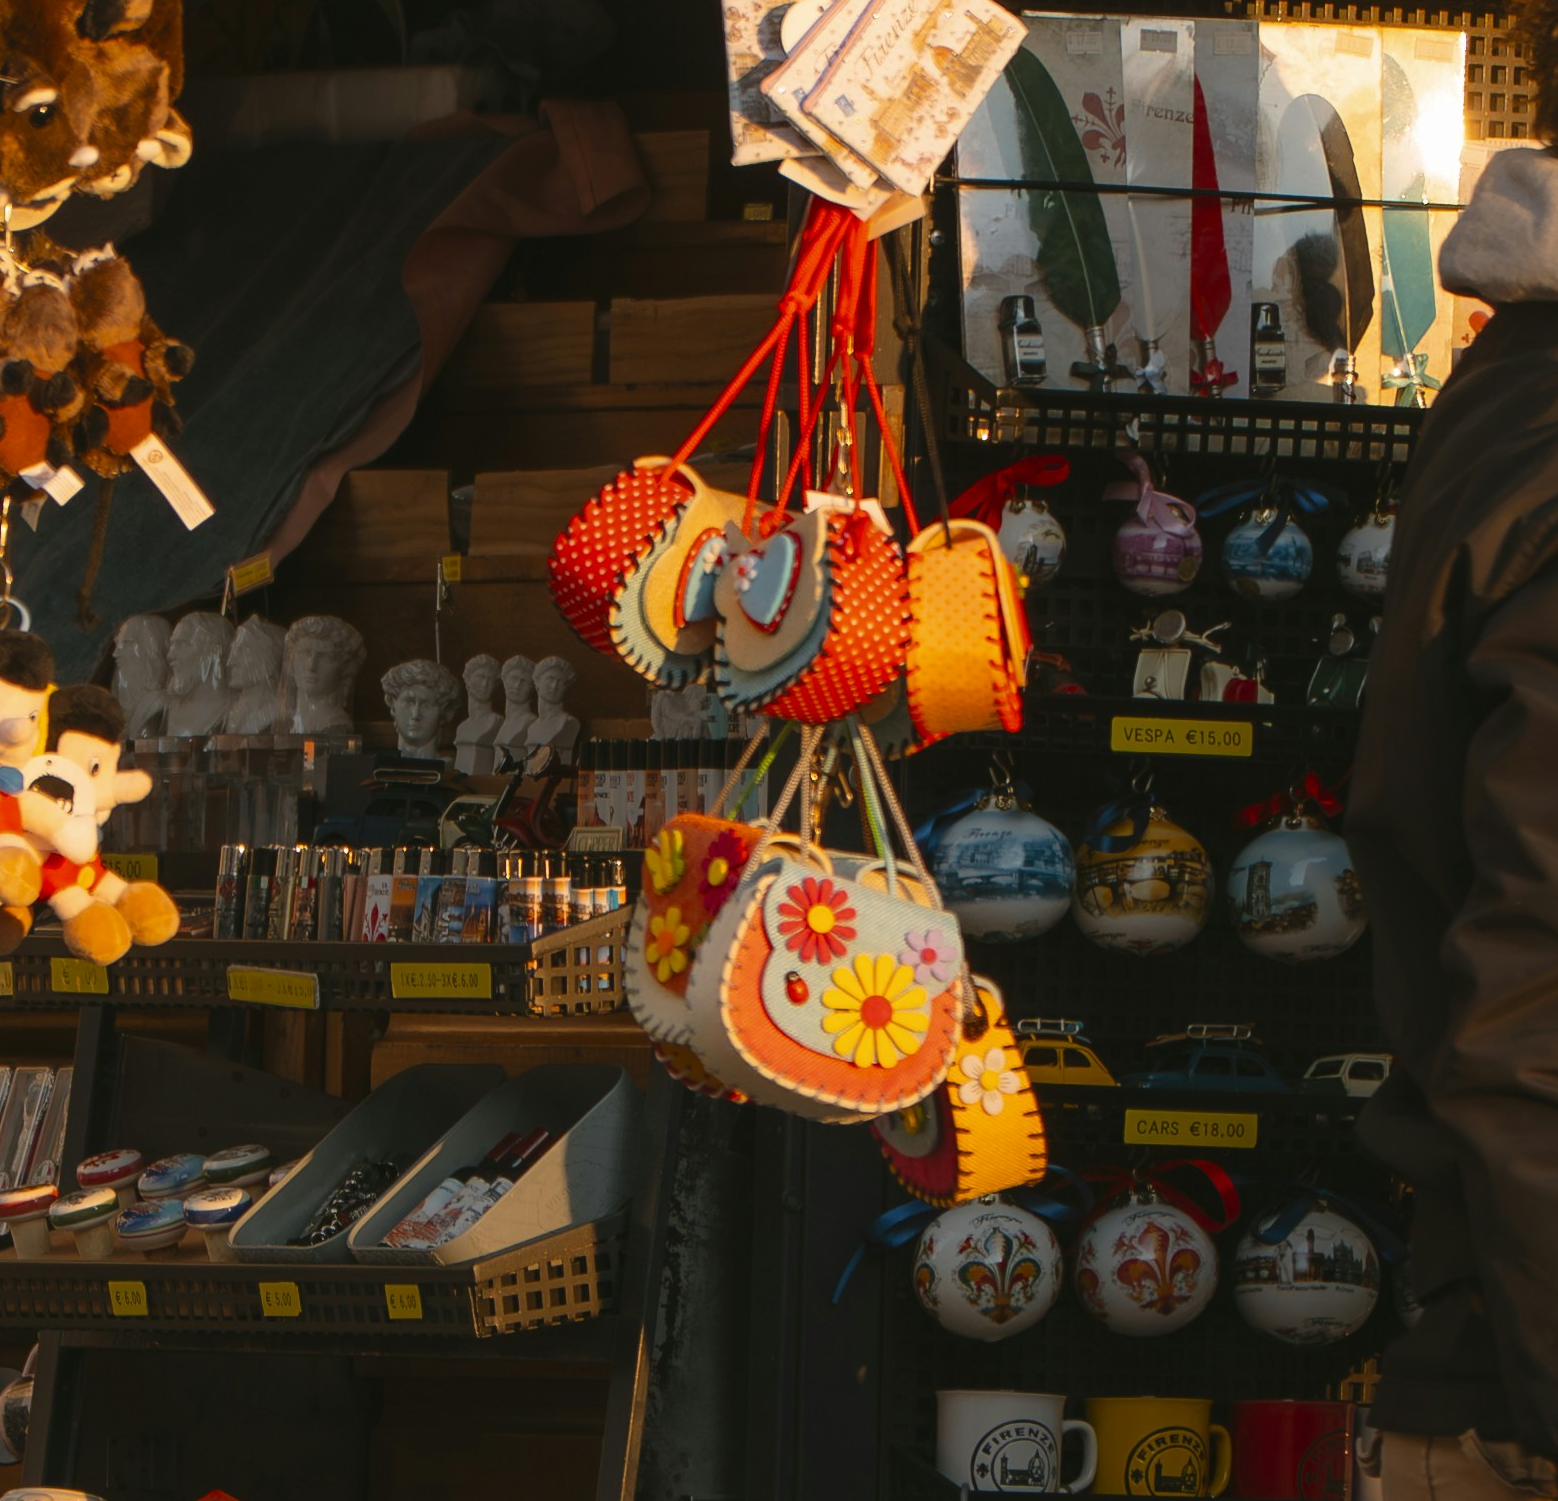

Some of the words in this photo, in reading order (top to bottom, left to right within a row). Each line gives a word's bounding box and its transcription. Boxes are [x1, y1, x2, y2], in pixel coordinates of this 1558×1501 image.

[1124, 727, 1175, 744] VESPA
[1136, 1120, 1179, 1136] CARS
[982, 1426, 1056, 1457] FIRENZE
